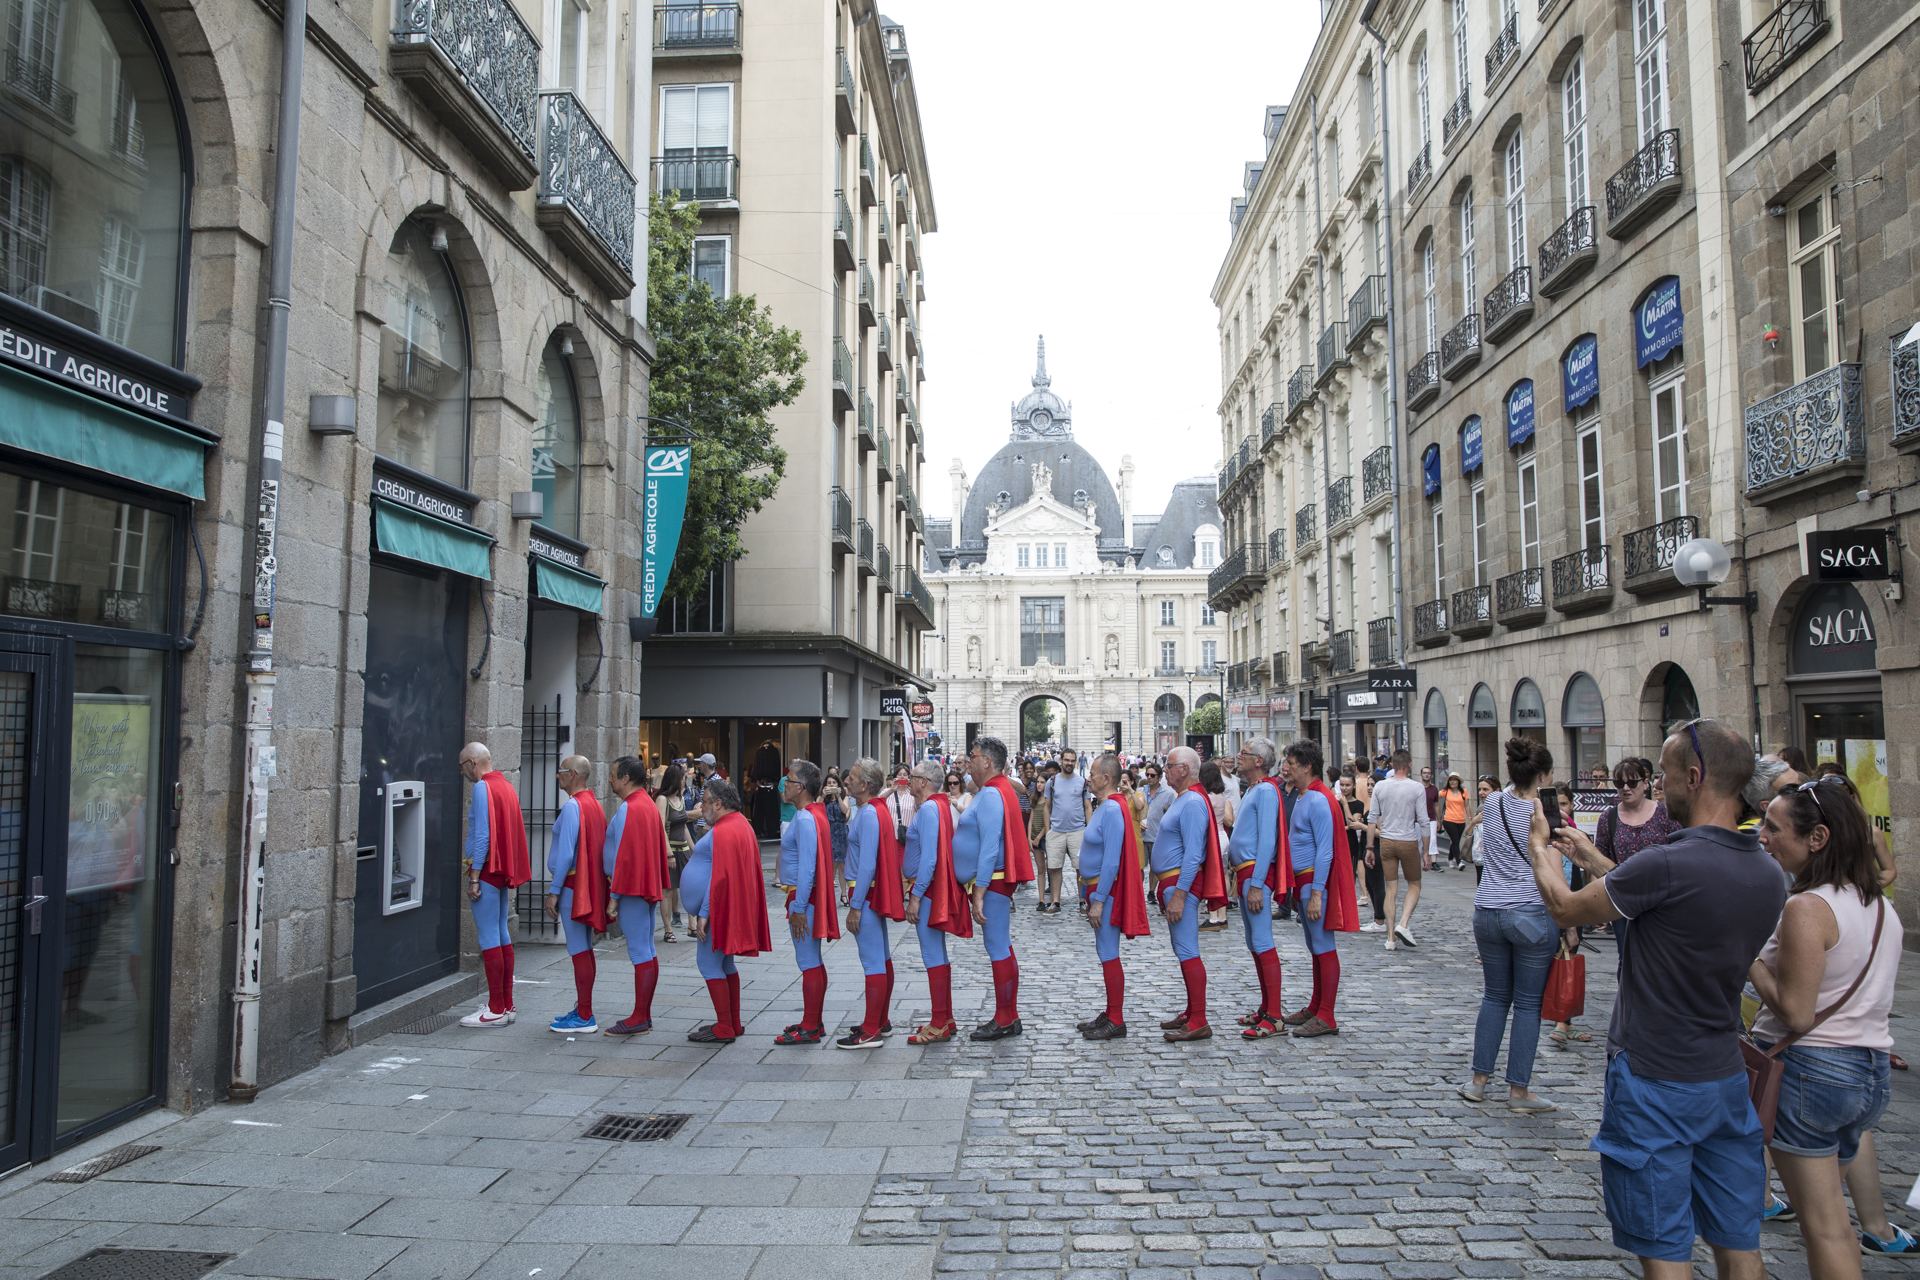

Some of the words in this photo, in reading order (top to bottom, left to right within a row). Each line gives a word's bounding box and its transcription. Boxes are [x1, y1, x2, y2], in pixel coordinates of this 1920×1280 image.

[414, 305, 446, 333] AGRICOLE
[1645, 294, 1678, 328] MARTIN
[1641, 326, 1684, 359] IMMOBILIER
[1570, 350, 1594, 376] MARTIN
[61, 356, 169, 413] AGRICOLE
[1568, 378, 1598, 402] IMMOBILIER
[376, 477, 416, 504] CRÉDIT
[416, 493, 464, 522] AGRICOLE
[646, 479, 659, 556] AGRICOLE
[550, 546, 579, 567] AGRICOLE
[1820, 545, 1883, 568] SAGA
[644, 558, 656, 614] CRÉDIT
[1809, 608, 1875, 646] SAGA
[1371, 679, 1414, 688] ZARA
[882, 698, 903, 708] pim
